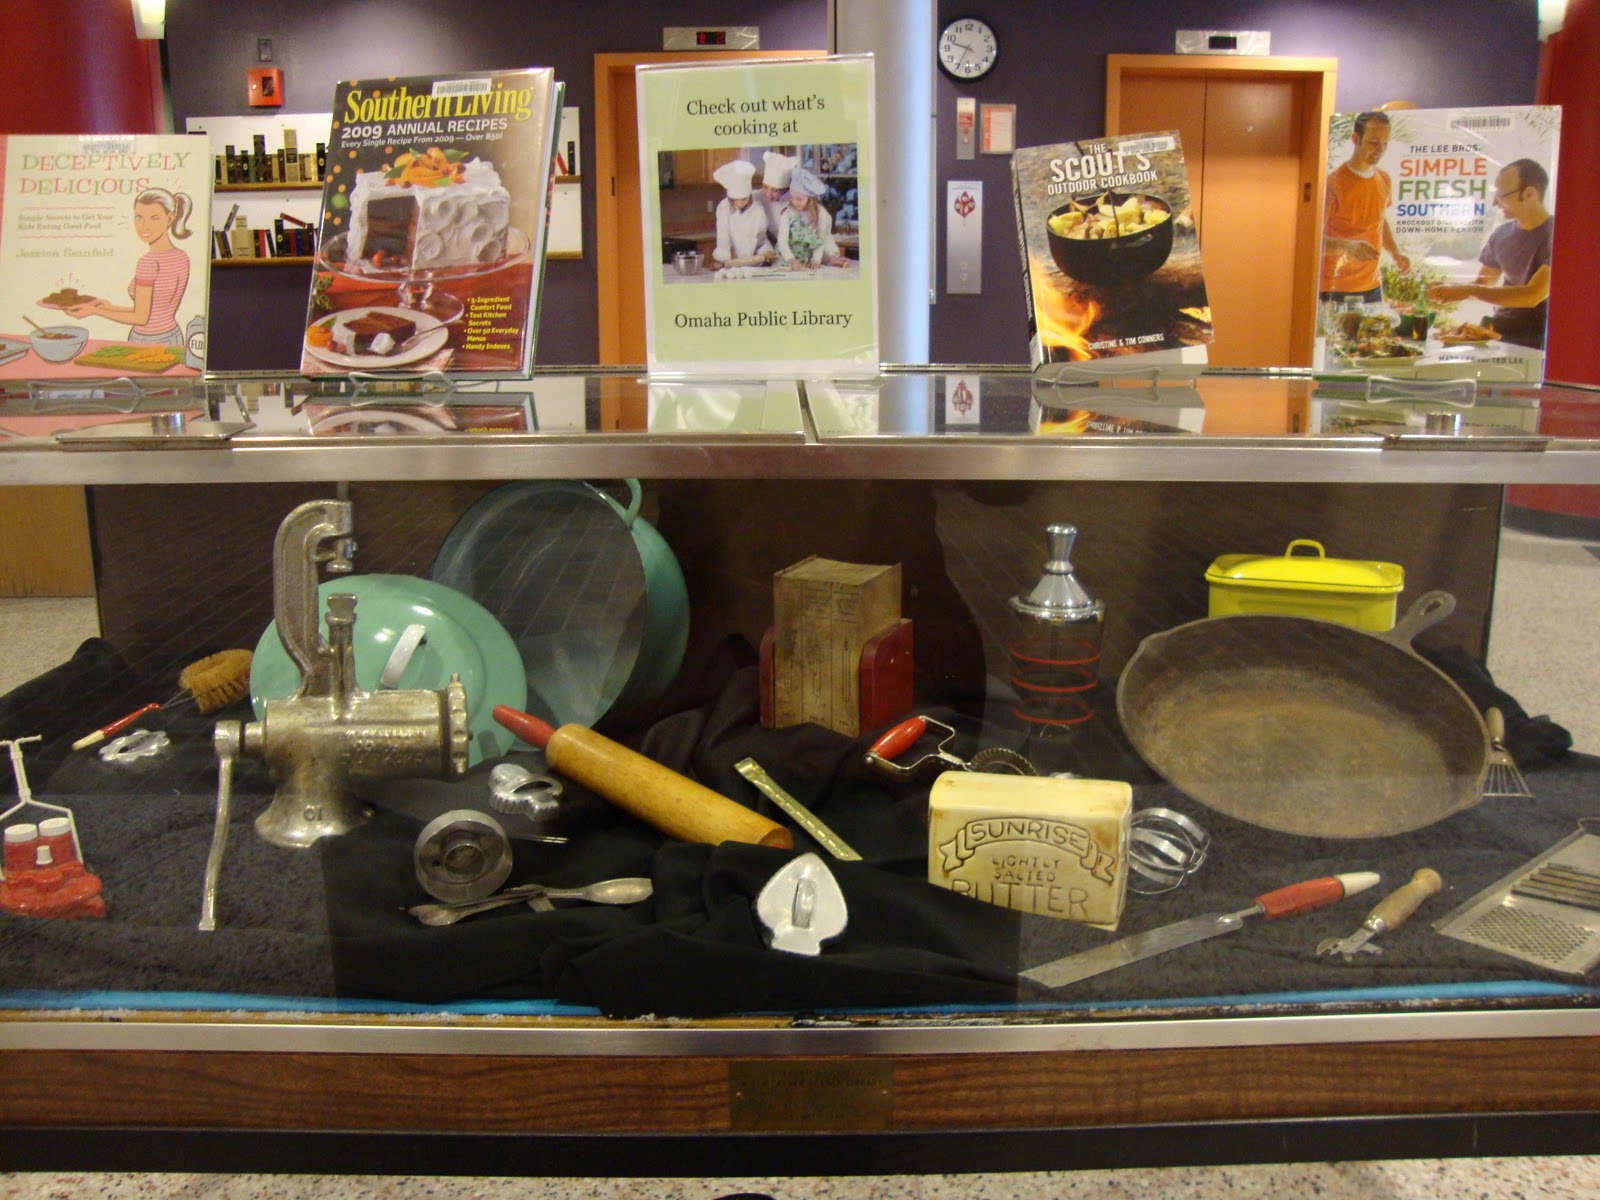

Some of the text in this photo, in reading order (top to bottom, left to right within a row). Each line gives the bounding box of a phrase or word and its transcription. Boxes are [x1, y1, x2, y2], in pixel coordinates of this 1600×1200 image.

[343, 81, 535, 124] Southern Living
[686, 97, 737, 116] Check
[740, 98, 768, 114] out
[341, 117, 508, 140] 2009 ANNUAL RECIPES
[714, 118, 799, 138] cooking at
[341, 131, 504, 149] Every Single Recipe From 2009 Over 850!
[1089, 143, 1106, 154] THE
[1410, 144, 1480, 153] THE LEE BROS.
[21, 151, 192, 172] DECEPTIVELY
[1399, 157, 1487, 177] SIMPLE
[19, 176, 151, 196] DELICIOUS
[1047, 170, 1158, 195] OUTDOOR COOKBOOK
[1398, 179, 1486, 200] FRESH
[674, 310, 852, 328] Omaha Public Library
[1088, 339, 1117, 350] CHRISTINE
[1124, 337, 1137, 346] TIM
[1137, 333, 1165, 344] CONNERS
[970, 819, 1088, 851] SUNRISE
[991, 855, 1060, 869] LIGHTLY
[994, 870, 1056, 882] SALTED
[951, 879, 1089, 918] BUTTER
